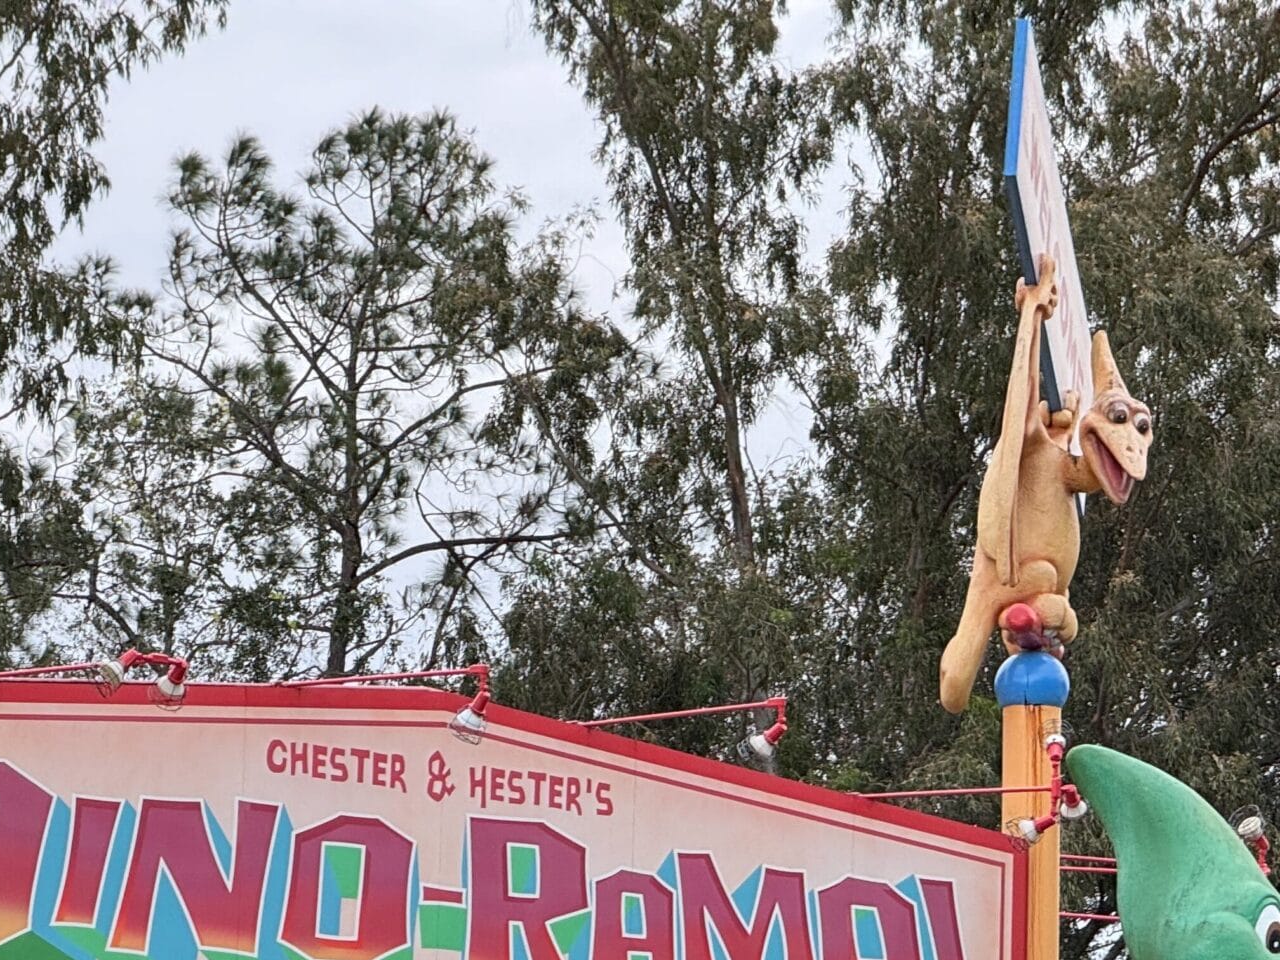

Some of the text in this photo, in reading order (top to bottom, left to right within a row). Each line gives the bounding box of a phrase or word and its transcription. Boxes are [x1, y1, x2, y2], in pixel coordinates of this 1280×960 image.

[266, 739, 614, 816] CHESTER & HESTER'S
